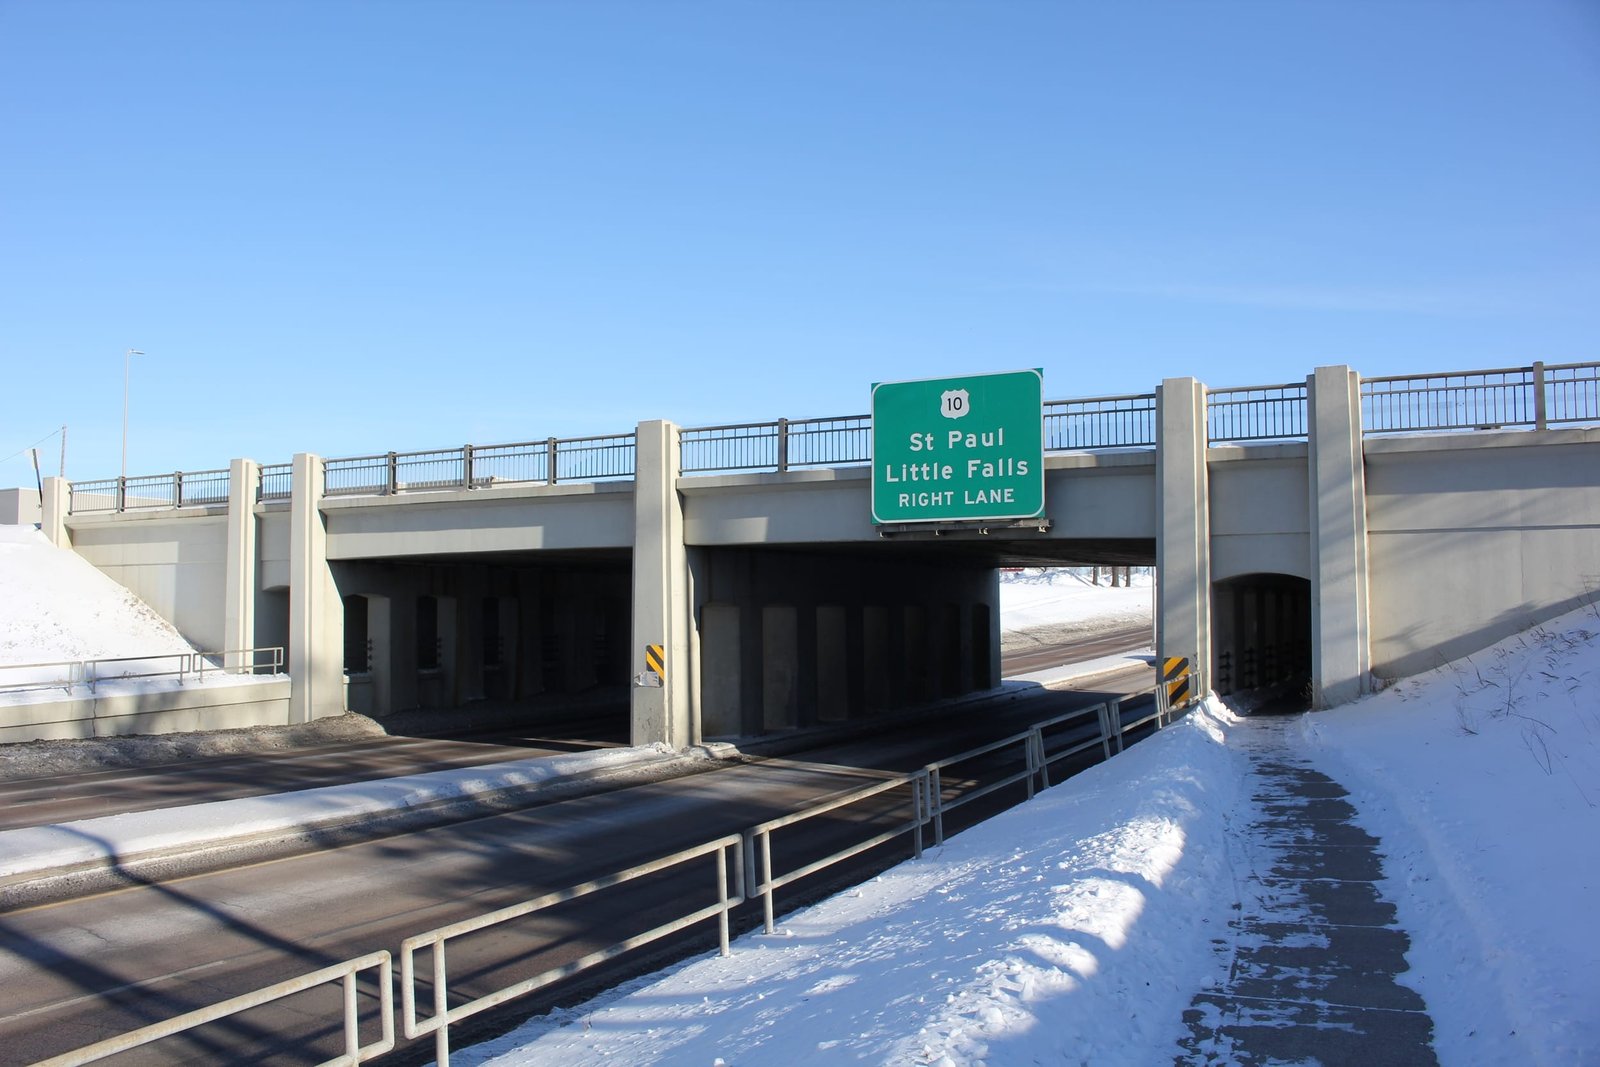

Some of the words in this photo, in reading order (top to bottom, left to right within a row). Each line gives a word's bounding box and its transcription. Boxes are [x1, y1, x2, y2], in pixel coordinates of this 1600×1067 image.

[947, 397, 962, 411] 10
[909, 433, 934, 451] St
[948, 428, 1003, 449] Paul
[886, 462, 953, 483] Little
[967, 458, 1028, 479] Falls
[899, 492, 954, 507] RIGHT
[964, 489, 1015, 505] LANE
